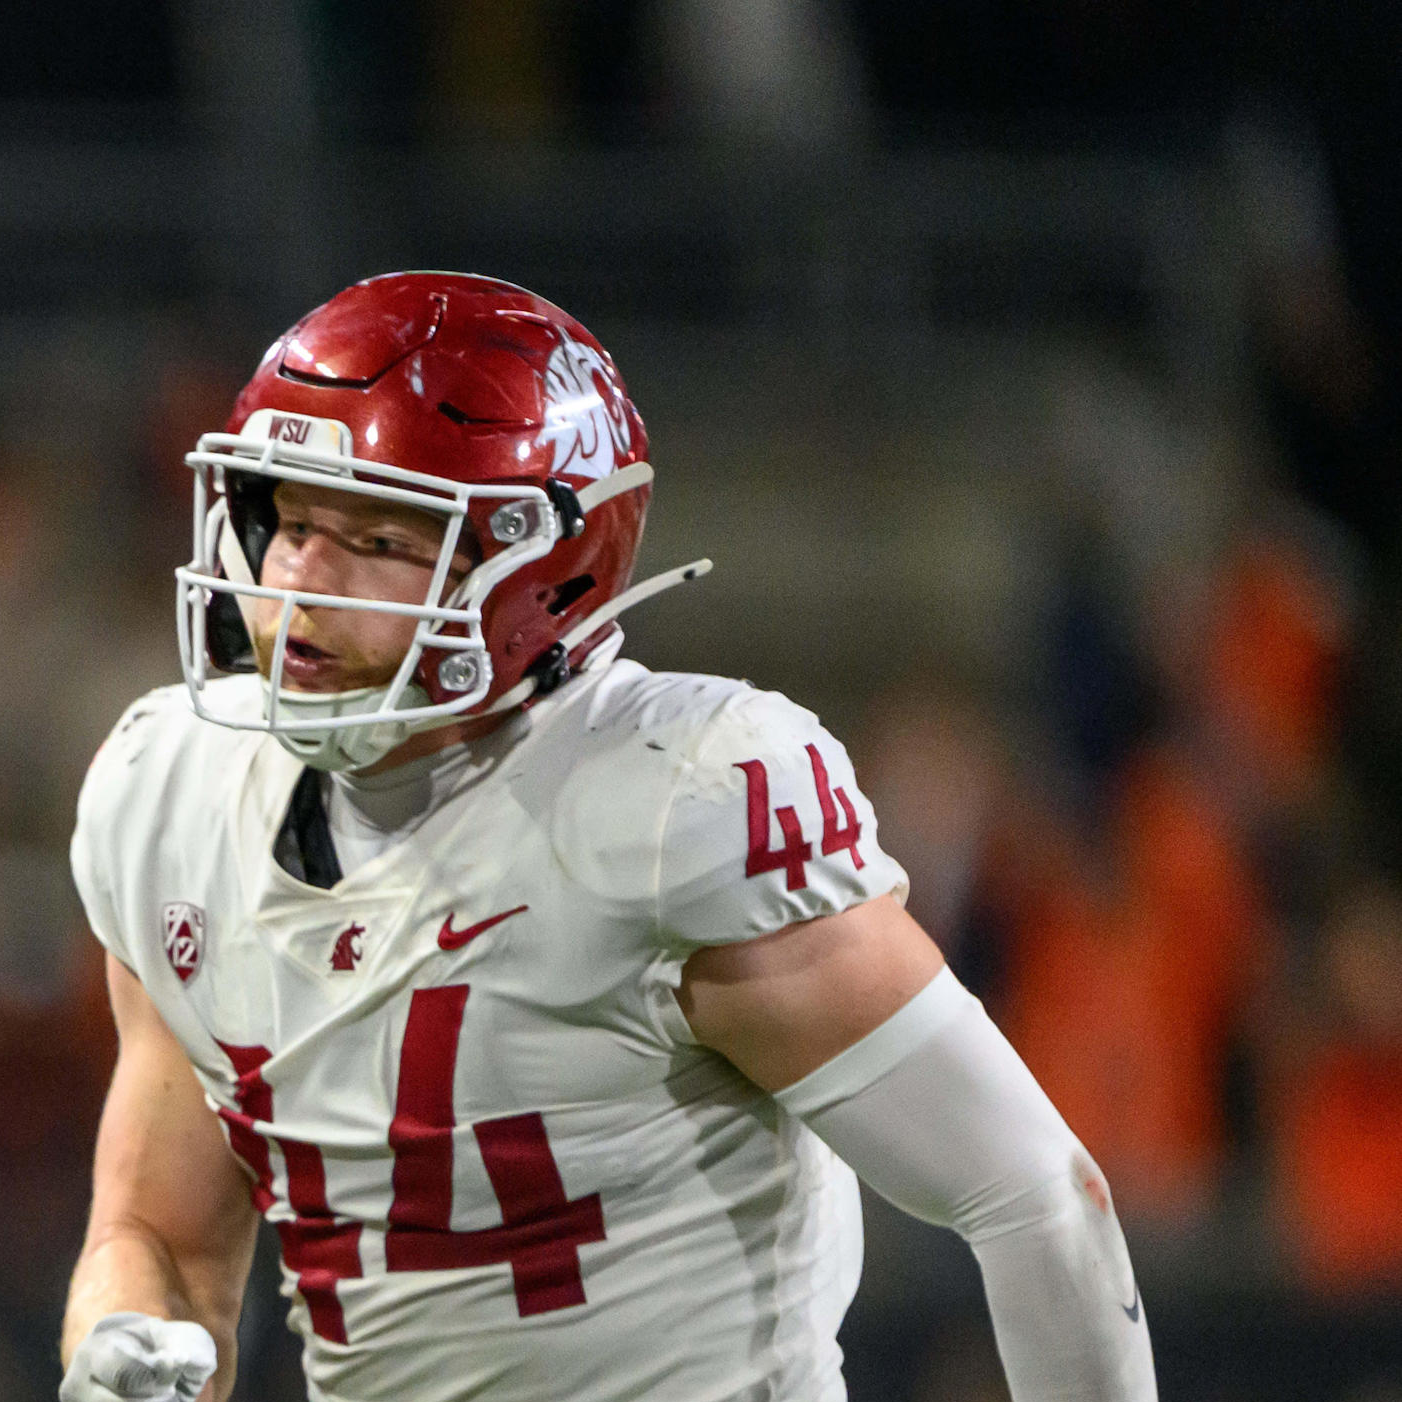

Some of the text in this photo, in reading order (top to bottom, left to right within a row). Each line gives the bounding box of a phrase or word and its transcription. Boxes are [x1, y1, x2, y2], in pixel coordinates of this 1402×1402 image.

[268, 416, 311, 445] WSU
[732, 742, 866, 892] 44
[172, 936, 197, 968] 12
[214, 984, 606, 1345] 44
